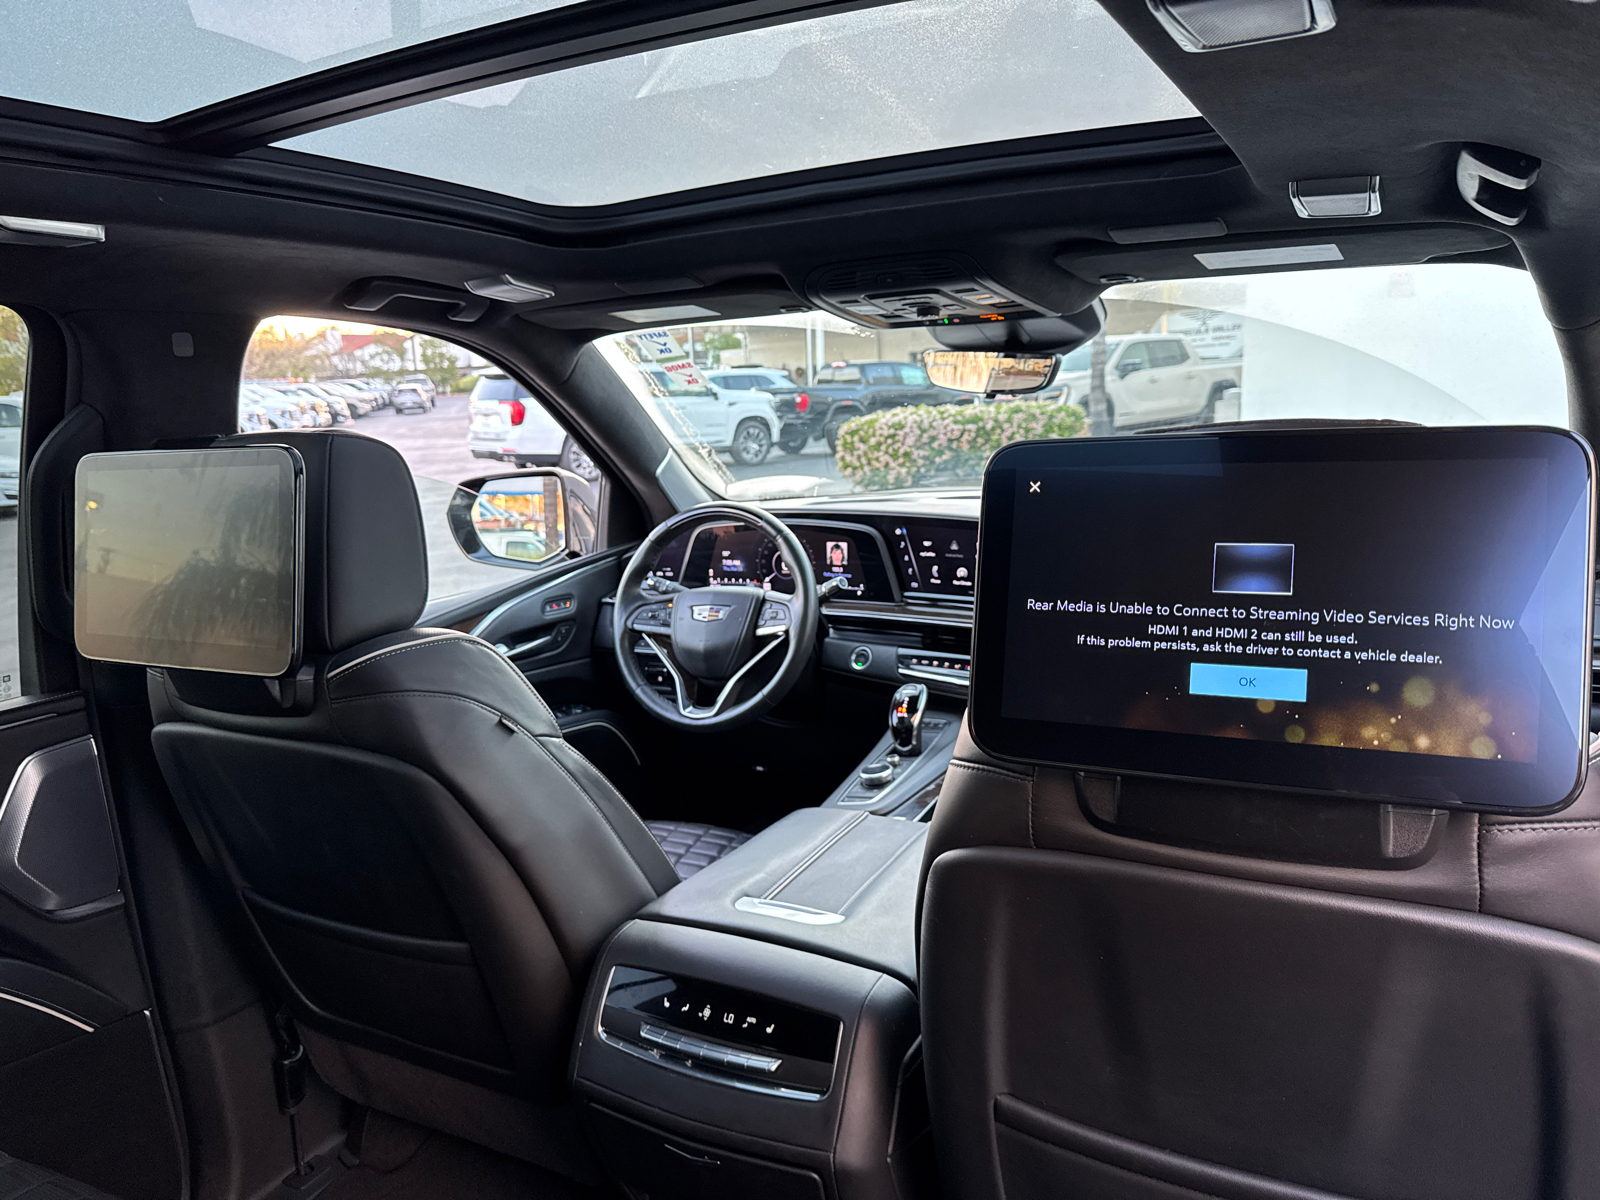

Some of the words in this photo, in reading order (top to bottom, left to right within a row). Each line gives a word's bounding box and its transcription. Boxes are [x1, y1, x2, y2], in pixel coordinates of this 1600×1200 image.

[1027, 598, 1054, 611] Rear
[1056, 599, 1093, 613] Media
[1096, 601, 1106, 613] is
[1109, 601, 1153, 615] Unable
[1156, 604, 1170, 616] to
[1173, 603, 1229, 618] Connect
[1232, 606, 1246, 619] to
[1249, 606, 1320, 625] Streaming
[1323, 608, 1364, 624] Video
[1368, 610, 1430, 627] Services
[1434, 612, 1475, 631] Right
[1479, 614, 1515, 630] Now
[1148, 624, 1179, 636] HDMI
[1182, 625, 1188, 636] 1
[1191, 626, 1213, 638] and
[1215, 627, 1248, 640] HDMI
[1250, 629, 1258, 640] 2
[1260, 631, 1281, 641] can
[1284, 630, 1305, 642] still
[1308, 630, 1323, 643] be
[1325, 632, 1358, 645] used.
[1077, 634, 1086, 645] If
[1086, 634, 1106, 647] this
[1107, 636, 1151, 649] problem
[1153, 639, 1200, 653] persists,
[1202, 641, 1222, 653] ask
[1224, 641, 1243, 654] the
[1245, 642, 1279, 656] driver
[1281, 645, 1294, 656] to
[1296, 647, 1342, 659] contact
[1343, 650, 1351, 660] a
[1354, 648, 1397, 662] vehicle
[1400, 650, 1443, 665] dealer.
[1238, 676, 1257, 688] OK
